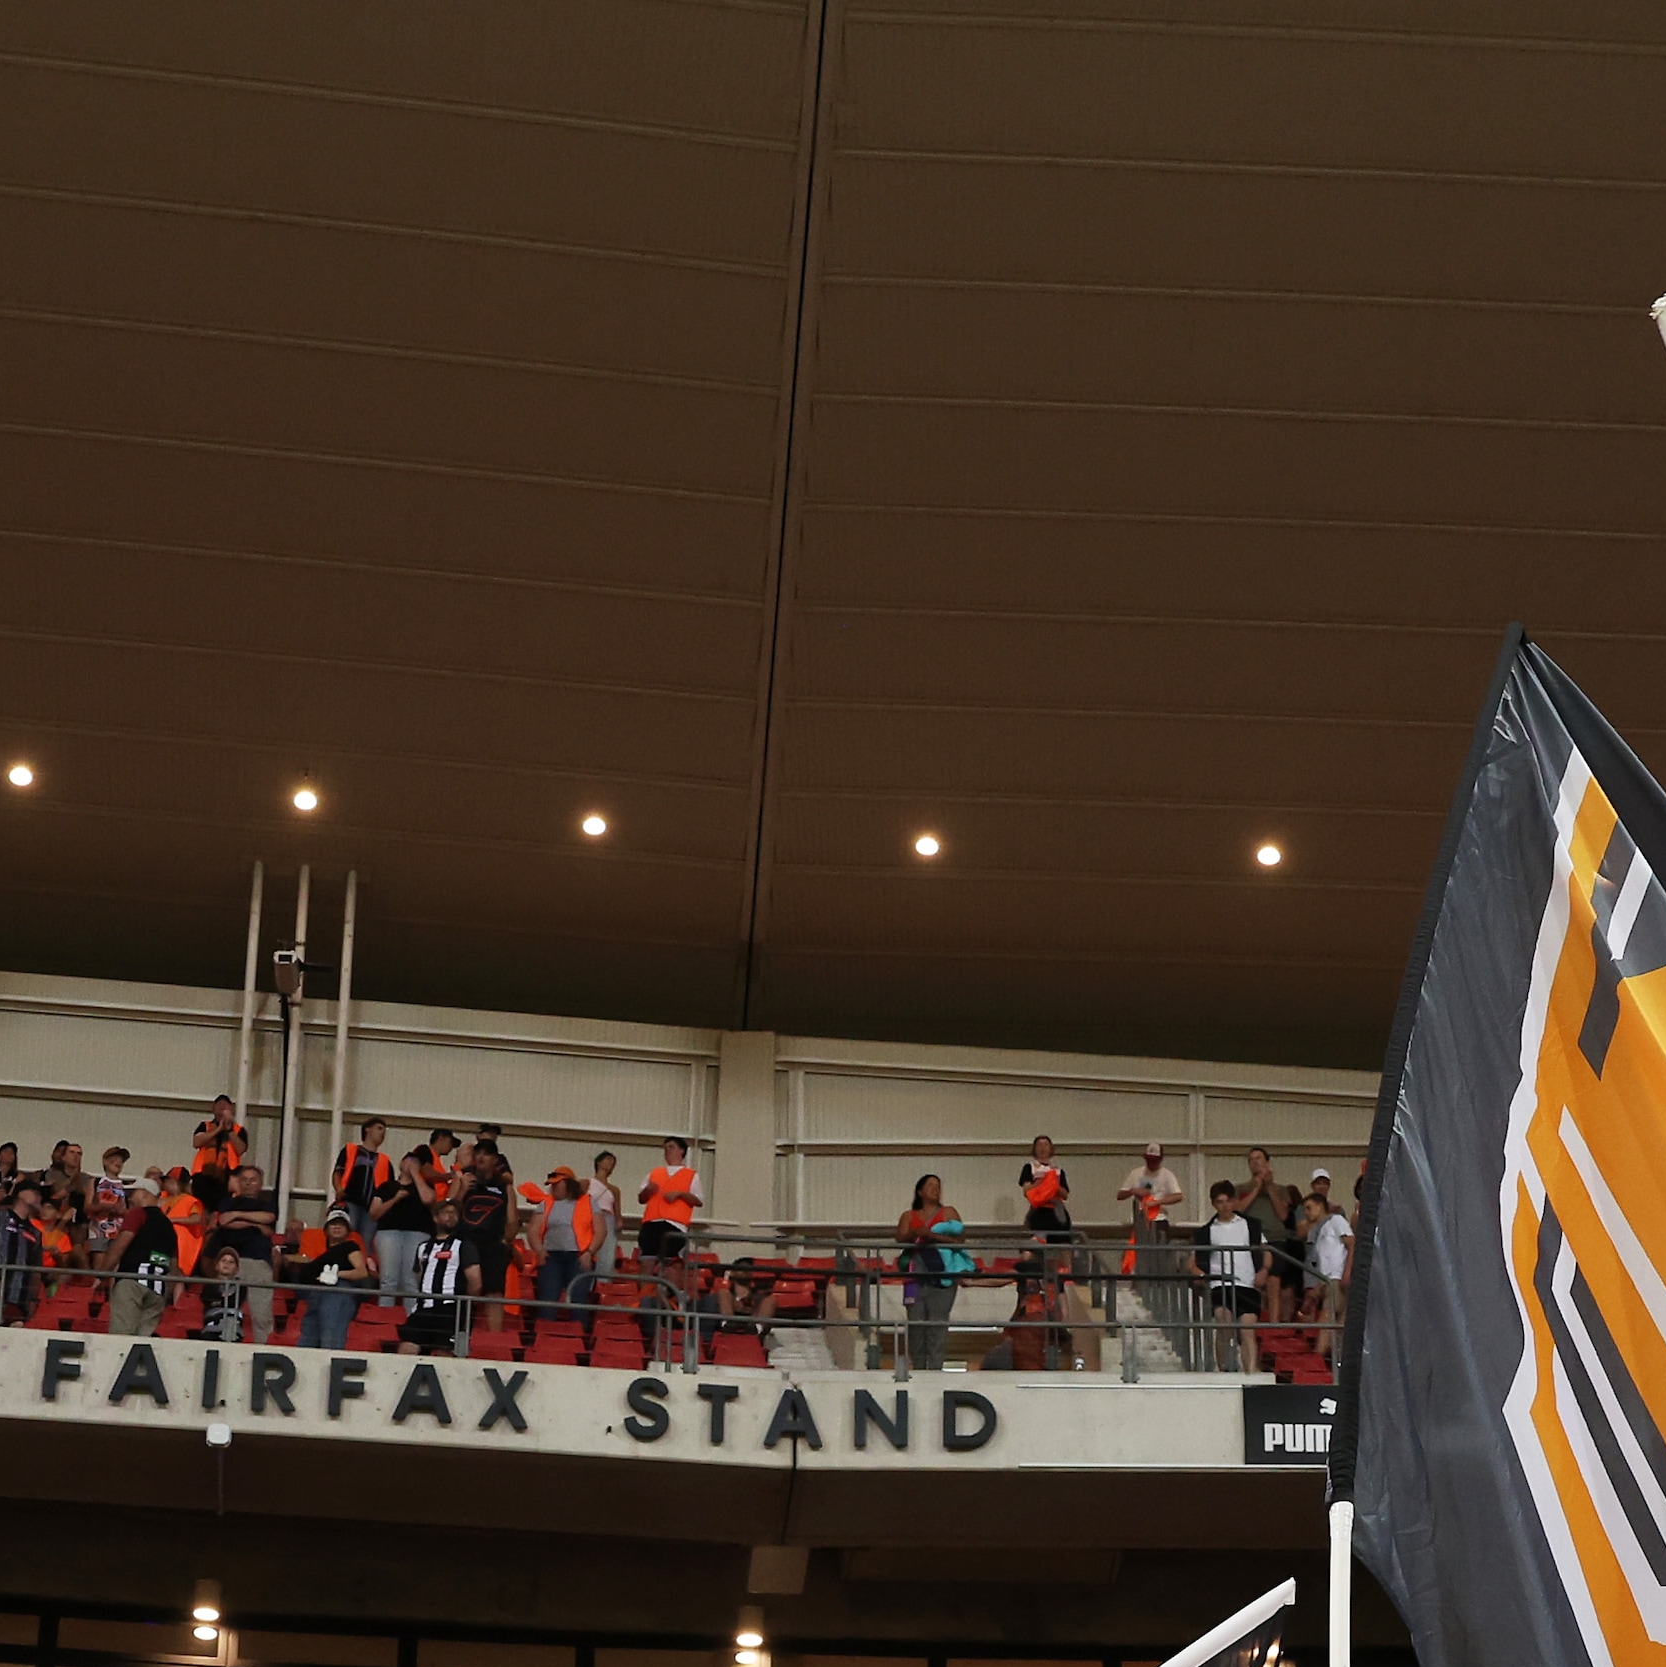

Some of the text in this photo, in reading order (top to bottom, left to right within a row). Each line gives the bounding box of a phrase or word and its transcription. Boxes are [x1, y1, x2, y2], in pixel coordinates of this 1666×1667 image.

[41, 1339, 529, 1432] FAIRFAX
[623, 1378, 998, 1452] STAND
[1264, 1423, 1333, 1453] PUM
